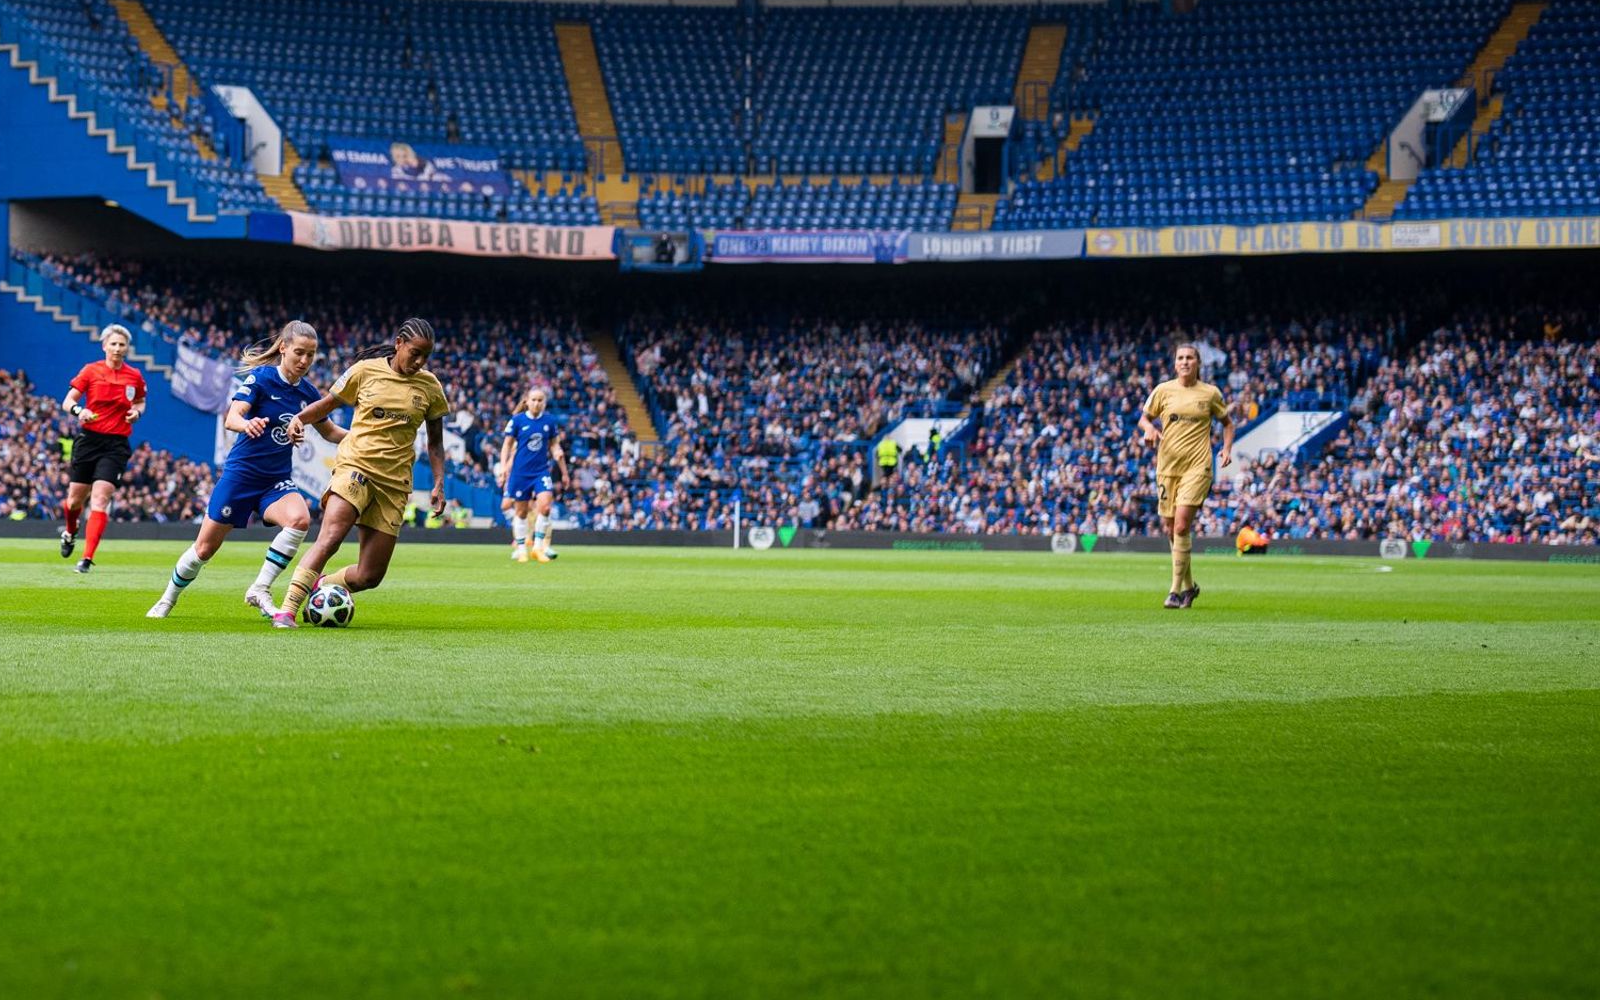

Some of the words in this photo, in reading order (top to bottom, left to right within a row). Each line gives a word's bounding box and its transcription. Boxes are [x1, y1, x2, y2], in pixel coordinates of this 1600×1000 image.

[339, 220, 454, 249] DROGBA
[474, 226, 585, 256] LEGEND
[1124, 230, 1160, 254] THE
[1174, 227, 1222, 252] ONLY
[1236, 225, 1300, 251] PLACE
[1316, 223, 1343, 249] TO
[1357, 224, 1384, 249] BE
[1450, 220, 1521, 248] EVERY
[1536, 218, 1600, 247] OTHE
